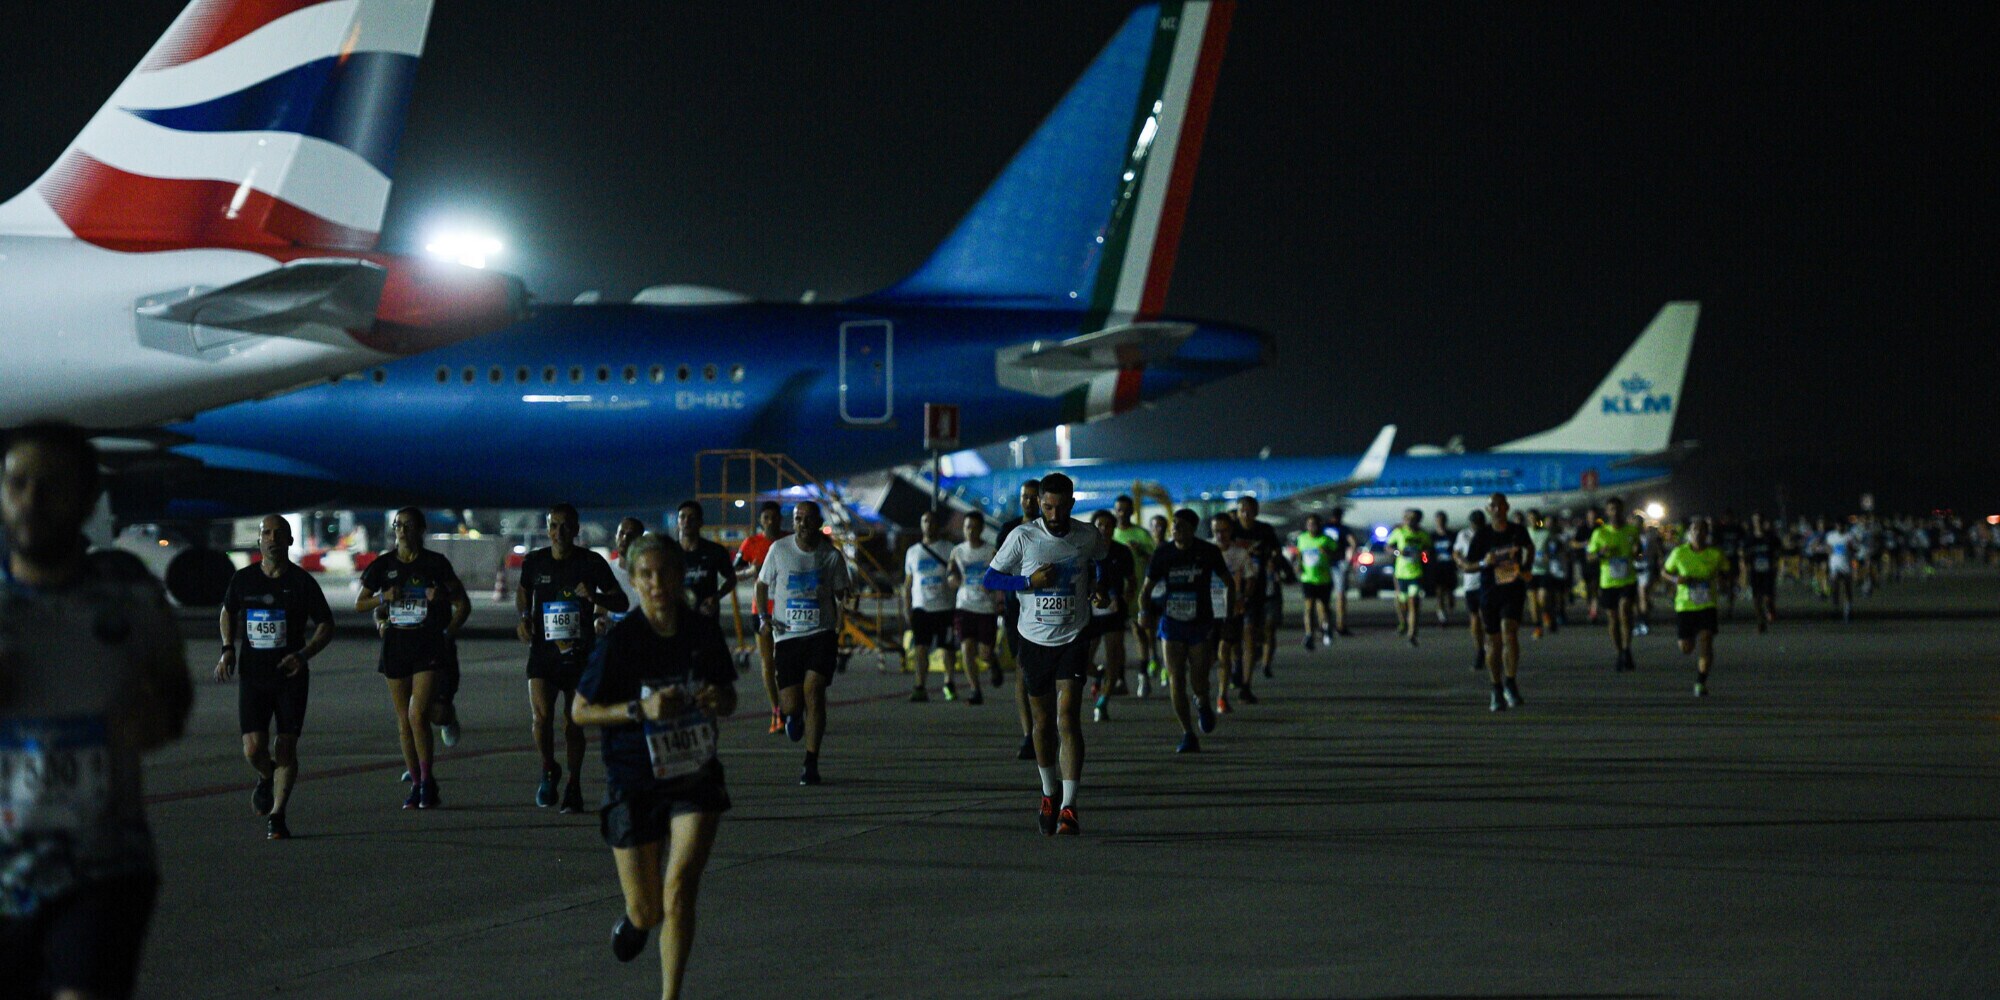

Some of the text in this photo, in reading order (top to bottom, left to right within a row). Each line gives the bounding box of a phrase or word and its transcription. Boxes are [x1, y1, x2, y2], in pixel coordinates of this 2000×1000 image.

[1603, 396, 1671, 414] KLM
[1042, 597, 1068, 610] 2281
[551, 613, 571, 625] 468
[791, 609, 813, 620] 2712
[256, 622, 276, 634] 458
[662, 728, 698, 752] 1401
